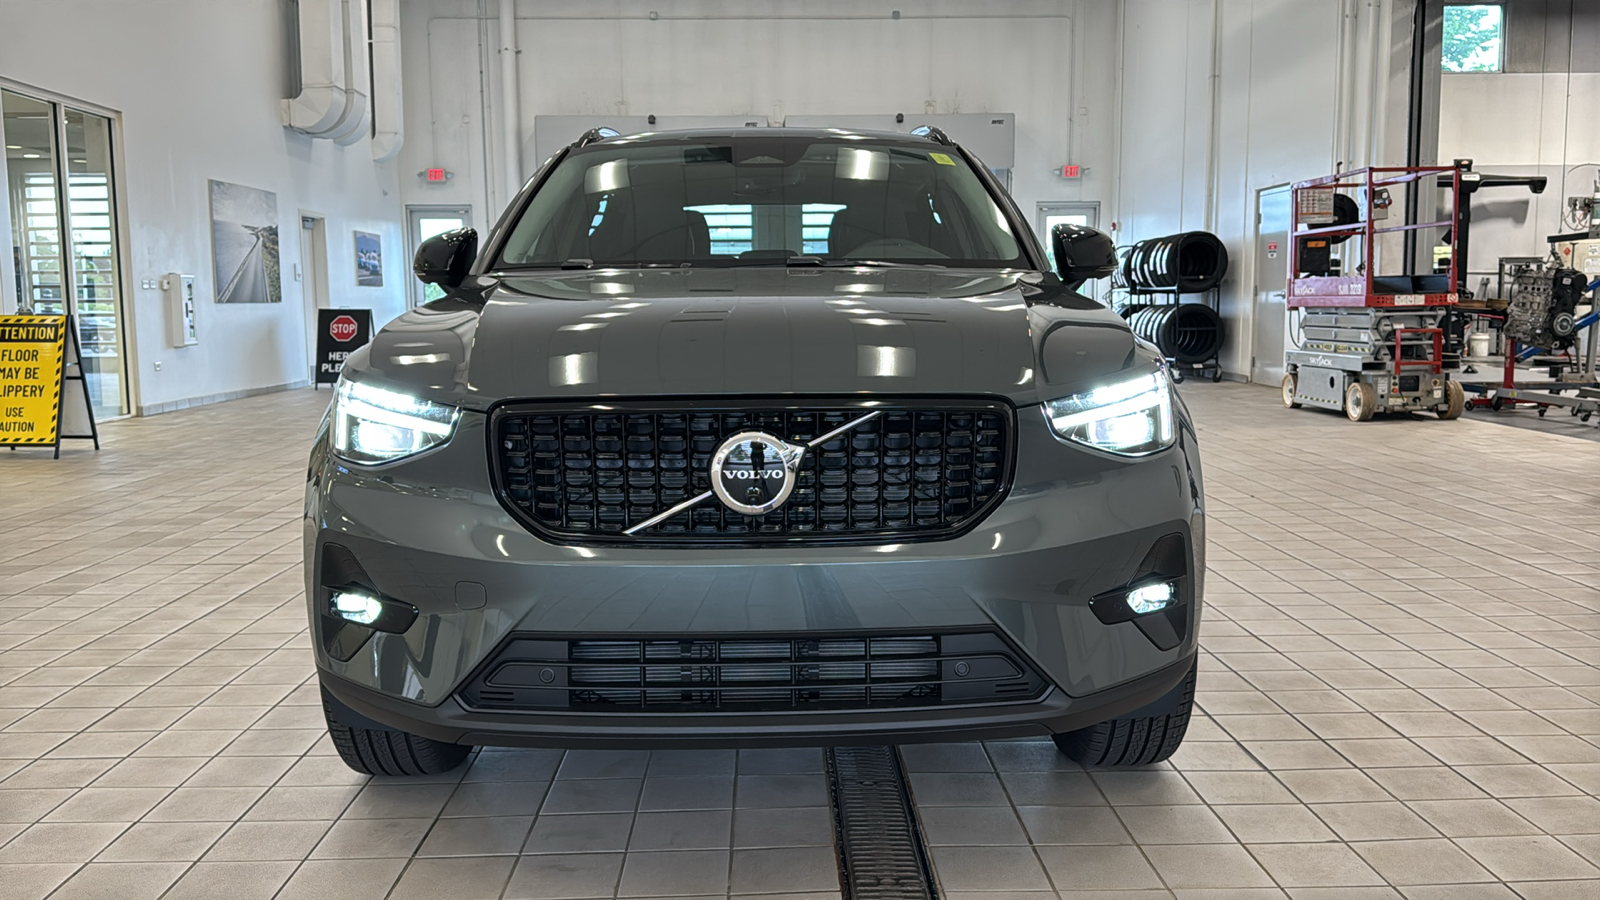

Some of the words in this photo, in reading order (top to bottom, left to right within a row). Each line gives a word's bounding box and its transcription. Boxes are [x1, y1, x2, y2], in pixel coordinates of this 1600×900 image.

[428, 168, 443, 180] EXIT
[1064, 165, 1079, 178] EXIT
[0, 327, 55, 340] TTENTION
[332, 323, 356, 334] STOP
[1, 349, 39, 362] FLOOR
[328, 351, 353, 361] HER
[24, 367, 40, 380] BE
[321, 363, 341, 373] PLE
[5, 407, 24, 418] USE
[0, 421, 35, 433] AUTION
[723, 469, 784, 480] VOLVO
